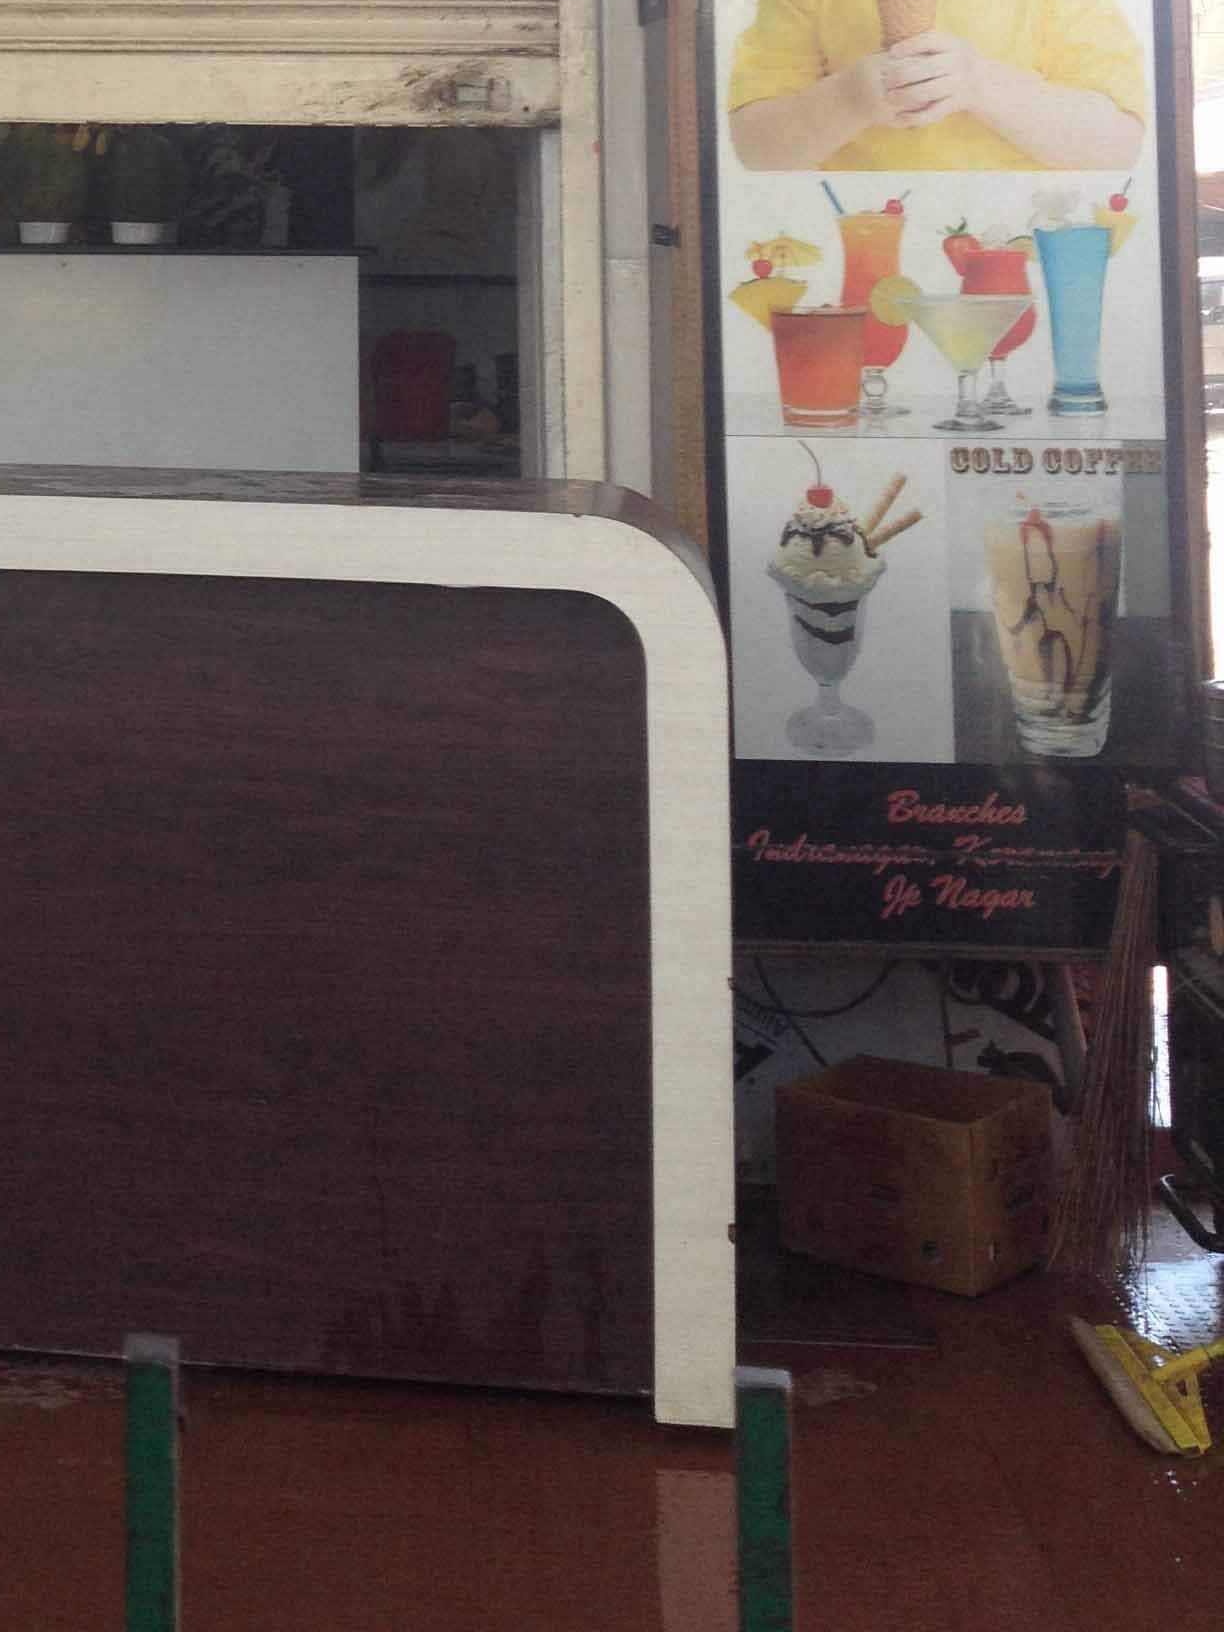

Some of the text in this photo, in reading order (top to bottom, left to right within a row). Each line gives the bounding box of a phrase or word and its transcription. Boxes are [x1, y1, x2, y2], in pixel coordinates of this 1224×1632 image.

[950, 447, 1035, 474] COLD
[887, 788, 1028, 825] Branches
[930, 875, 1035, 919] Nagar
